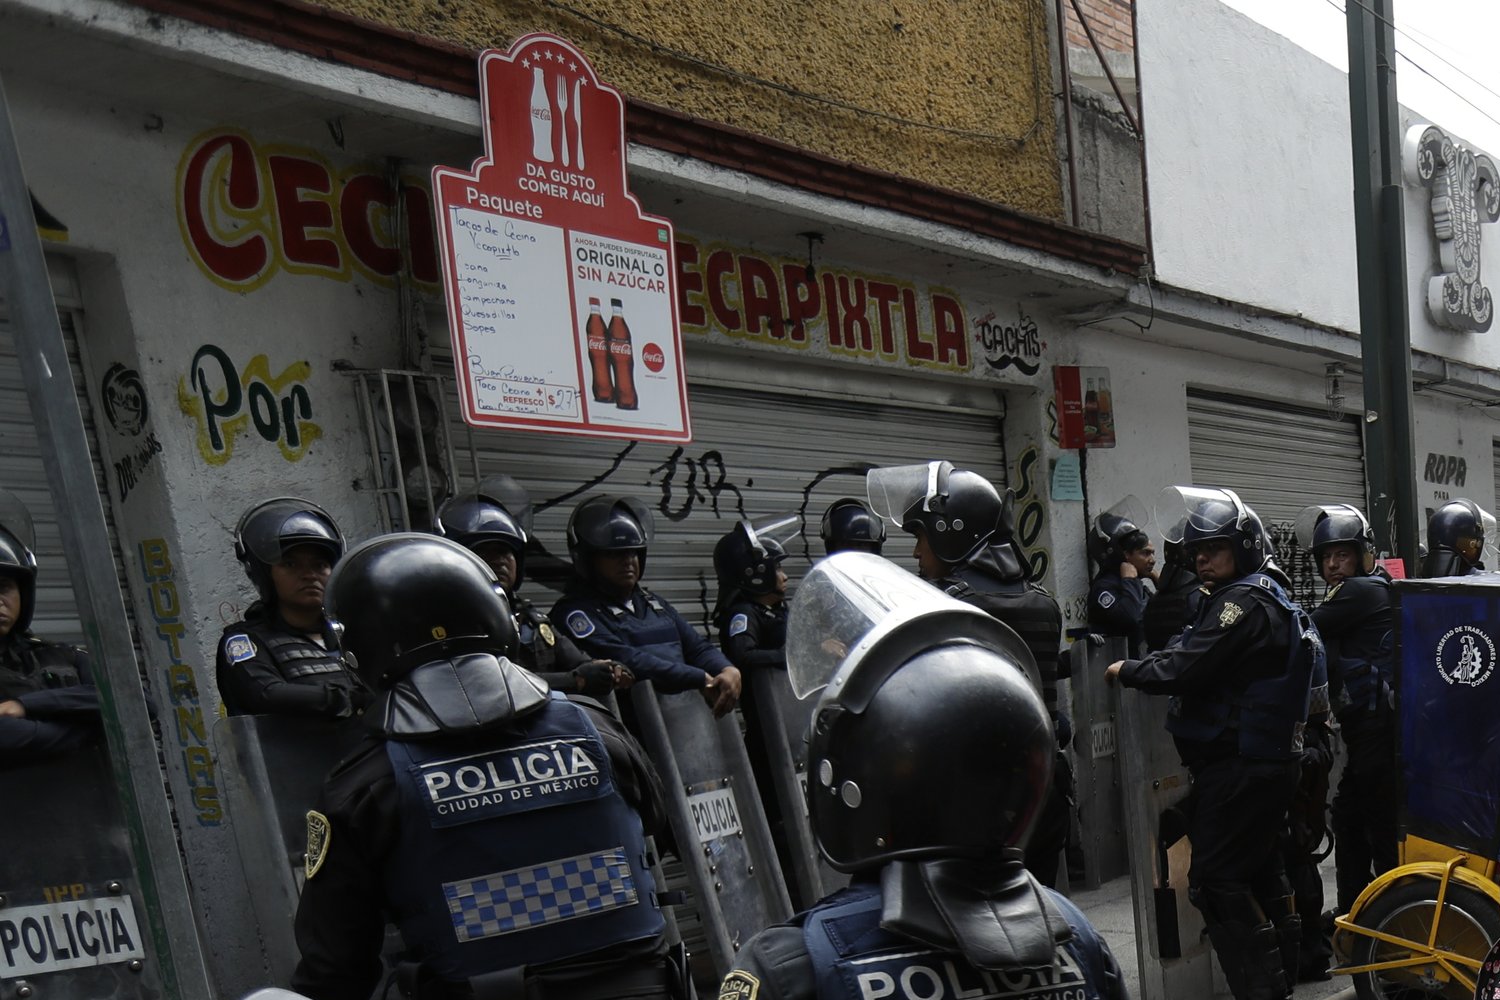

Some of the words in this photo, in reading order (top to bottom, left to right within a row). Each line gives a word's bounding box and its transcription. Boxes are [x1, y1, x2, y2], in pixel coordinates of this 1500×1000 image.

[518, 178, 569, 201] COMER
[571, 189, 606, 208] AQUÍ
[526, 162, 547, 179] DA
[550, 167, 595, 191] GUSTO
[184, 135, 439, 284] CECI
[466, 186, 543, 219] Paquete
[574, 237, 598, 248] AHORA
[599, 242, 623, 253] PUEDES
[624, 247, 664, 261] DISFRUTARLA
[576, 247, 650, 275] ORIGINAL
[653, 263, 665, 277] O
[577, 265, 603, 283] SIN
[606, 271, 666, 294] AZÚCAR
[674, 241, 968, 367] ECAPIXTLA
[190, 344, 313, 451] Por
[502, 395, 545, 407] REFRESCO
[1424, 452, 1467, 488] ROPA
[1434, 490, 1450, 501] PARA
[1436, 630, 1455, 656] LIBERTAD
[1454, 625, 1463, 634] DE
[1463, 625, 1497, 661] TRABAJADORES
[1487, 661, 1496, 671] DE
[138, 538, 226, 829] BOTANAS
[424, 744, 598, 801] POLICÍA
[437, 791, 504, 815] CIUDAD
[511, 786, 534, 800] DE
[539, 776, 600, 795] MÉXICO
[691, 796, 739, 836] POLICIA
[0, 907, 136, 968] POLICIA
